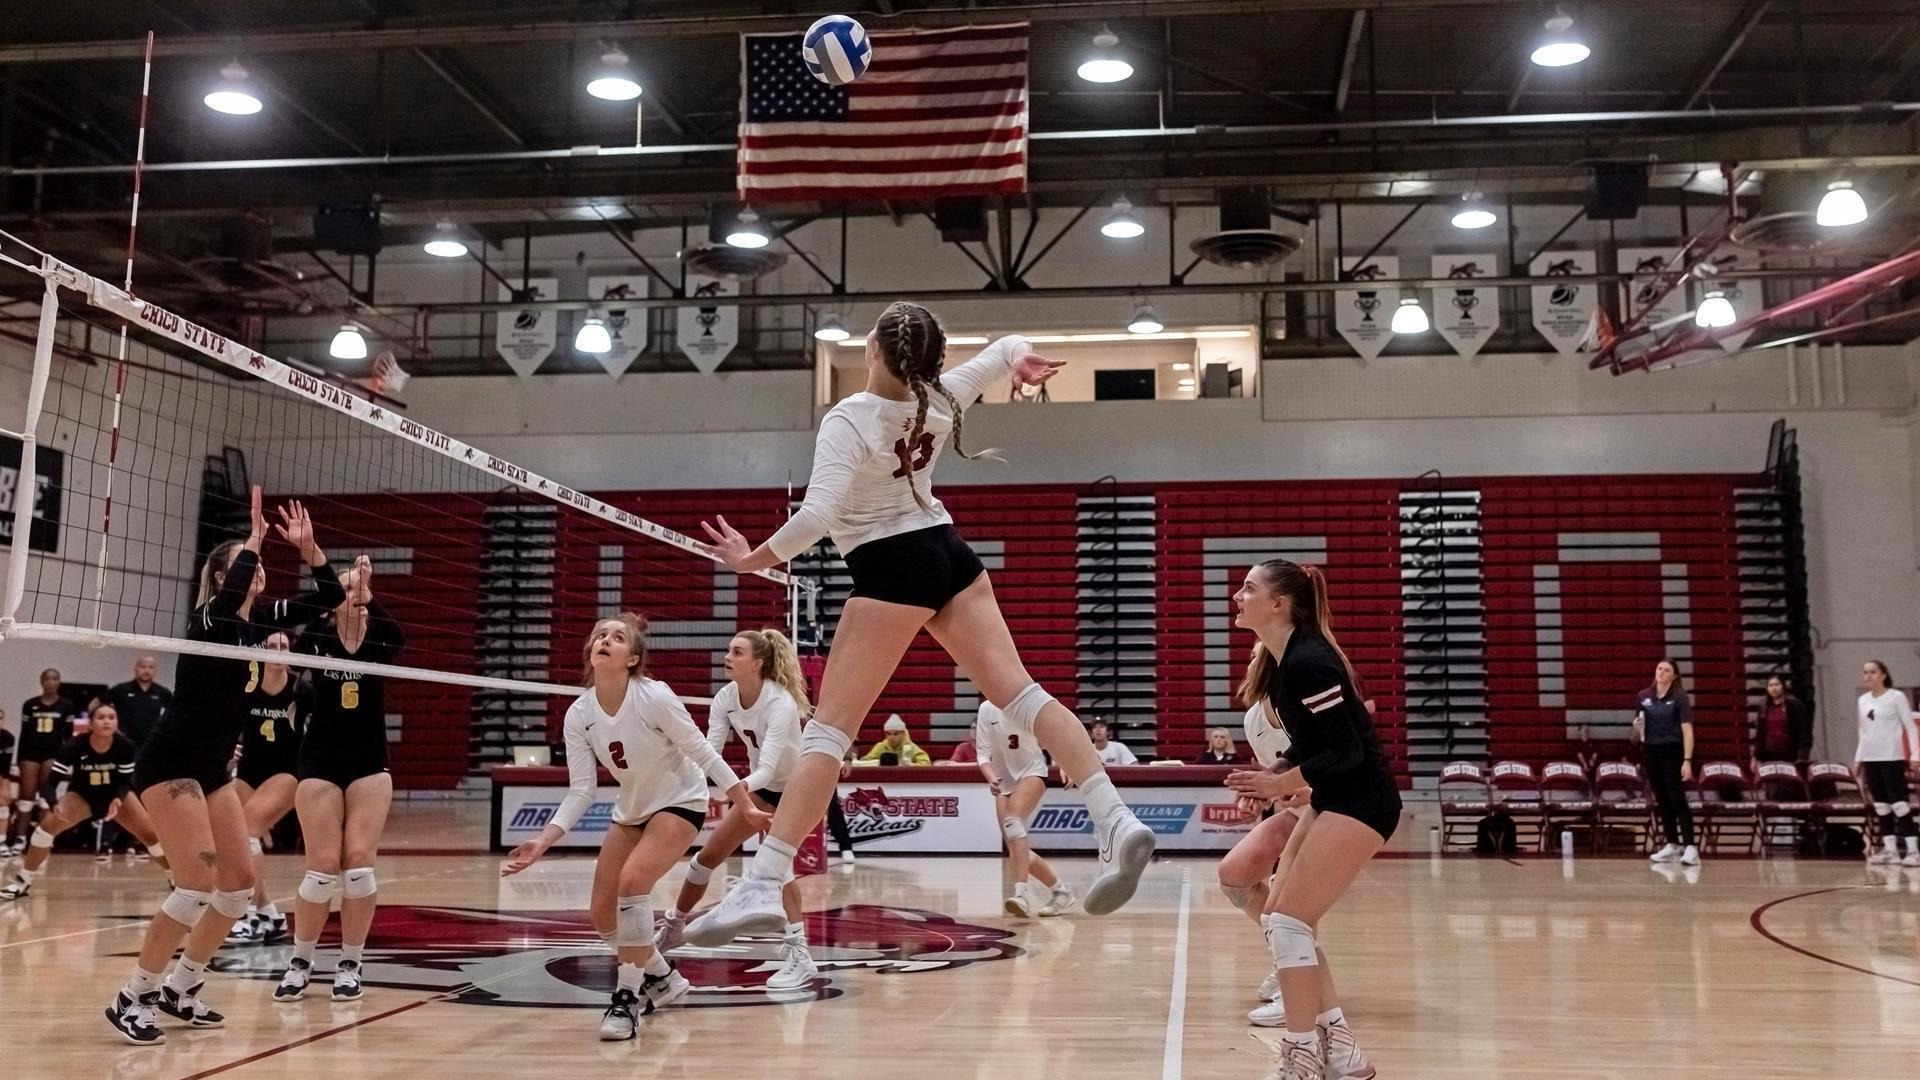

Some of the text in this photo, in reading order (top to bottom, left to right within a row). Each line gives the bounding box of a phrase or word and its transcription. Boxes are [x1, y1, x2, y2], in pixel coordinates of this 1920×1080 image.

[140, 302, 227, 354] CHICO STATE
[288, 369, 353, 410] CHICO STATE
[400, 418, 451, 451] CHICO STATE
[487, 456, 528, 483] CHICO STATE
[341, 681, 359, 709] 6
[261, 708, 289, 719] Angele
[1867, 708, 1875, 721] 4
[260, 719, 276, 742] 4
[743, 729, 760, 750] 7
[1008, 734, 1019, 750] 3
[608, 740, 629, 770] 2
[887, 797, 959, 817] STATE
[1131, 807, 1184, 817] ELLAND
[1209, 807, 1242, 821] brya
[510, 808, 556, 827] MA
[848, 818, 925, 834] ildcats
[1030, 809, 1090, 829] MAC
